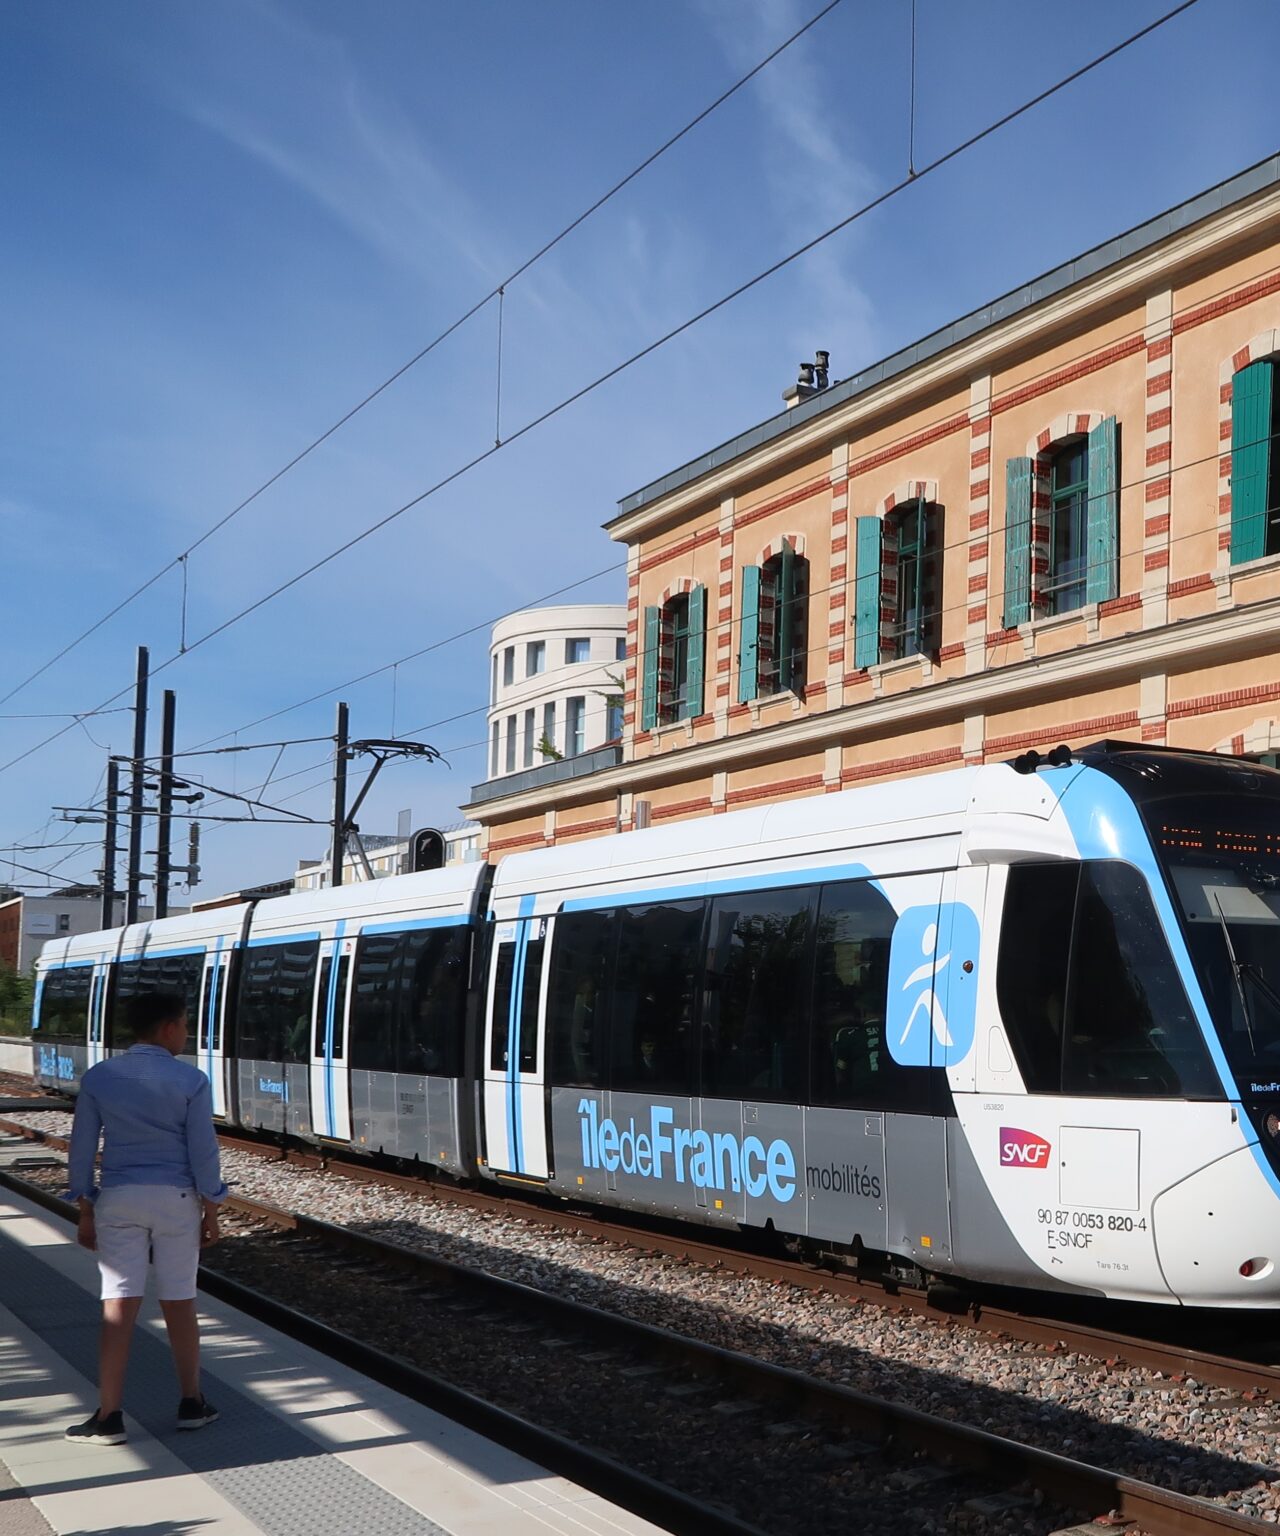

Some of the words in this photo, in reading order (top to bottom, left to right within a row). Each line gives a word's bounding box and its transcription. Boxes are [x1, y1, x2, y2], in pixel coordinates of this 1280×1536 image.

[983, 1103, 1005, 1111] U53820
[1001, 1142, 1048, 1164] SNCF
[806, 1162, 881, 1199] mobilités
[1037, 1208, 1053, 1224] 90
[1055, 1210, 1070, 1226] 87
[1072, 1212, 1105, 1230] 0053
[1107, 1215, 1148, 1232] 820-4
[1047, 1230, 1093, 1249] F-SNCF
[1096, 1260, 1112, 1269] Tare
